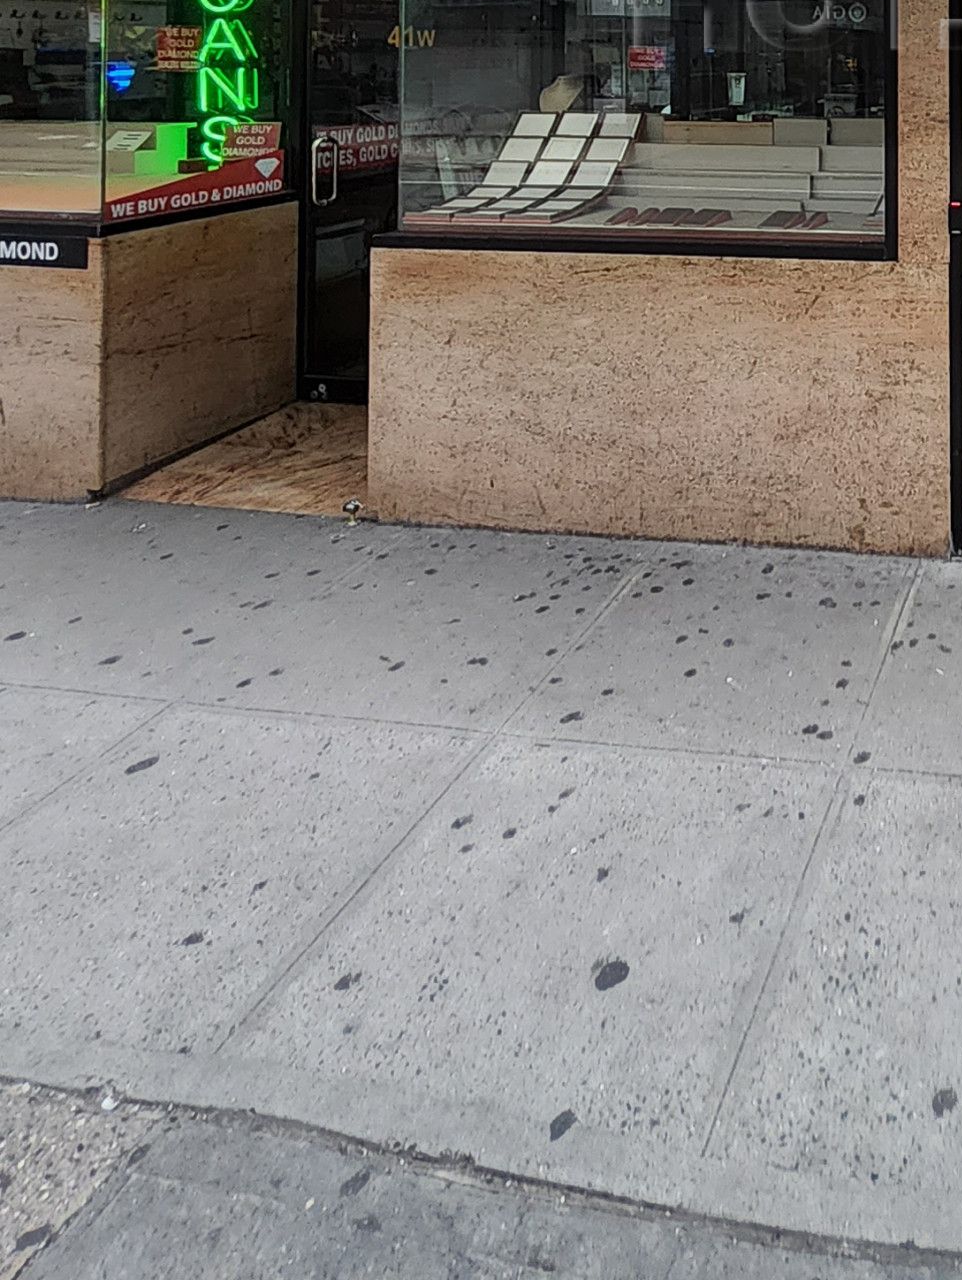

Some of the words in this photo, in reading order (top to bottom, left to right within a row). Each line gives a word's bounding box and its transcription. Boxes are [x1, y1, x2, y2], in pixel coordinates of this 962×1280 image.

[236, 135, 266, 145] GOLD
[222, 147, 277, 157] DIAMOND
[111, 201, 136, 218] WE
[137, 197, 168, 214] BUY
[170, 191, 209, 208] GOLD
[210, 188, 221, 202] &
[223, 179, 283, 199] DIAMOND
[0, 240, 59, 261] MOND
